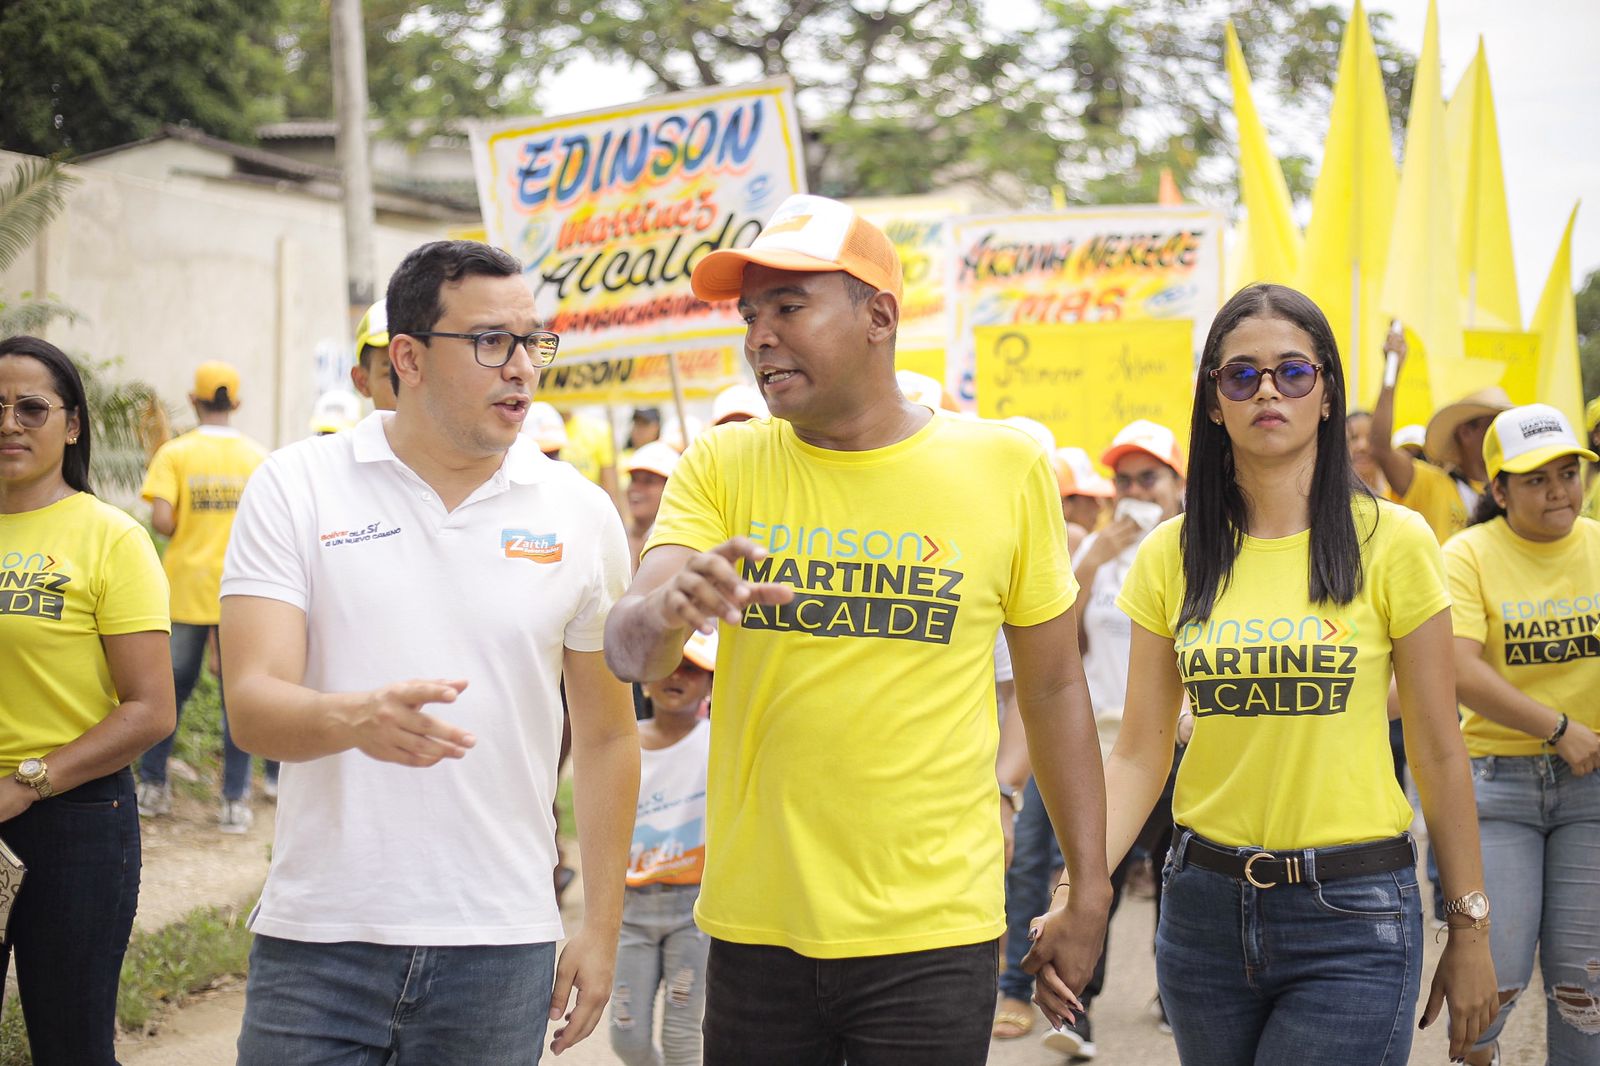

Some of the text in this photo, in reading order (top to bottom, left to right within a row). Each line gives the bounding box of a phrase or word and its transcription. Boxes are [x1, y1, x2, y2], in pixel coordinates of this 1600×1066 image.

[517, 99, 765, 205] EDINSON
[510, 535, 549, 551] Zaith
[743, 558, 964, 602] MARTINEZ
[744, 599, 949, 639] ALCALDE
